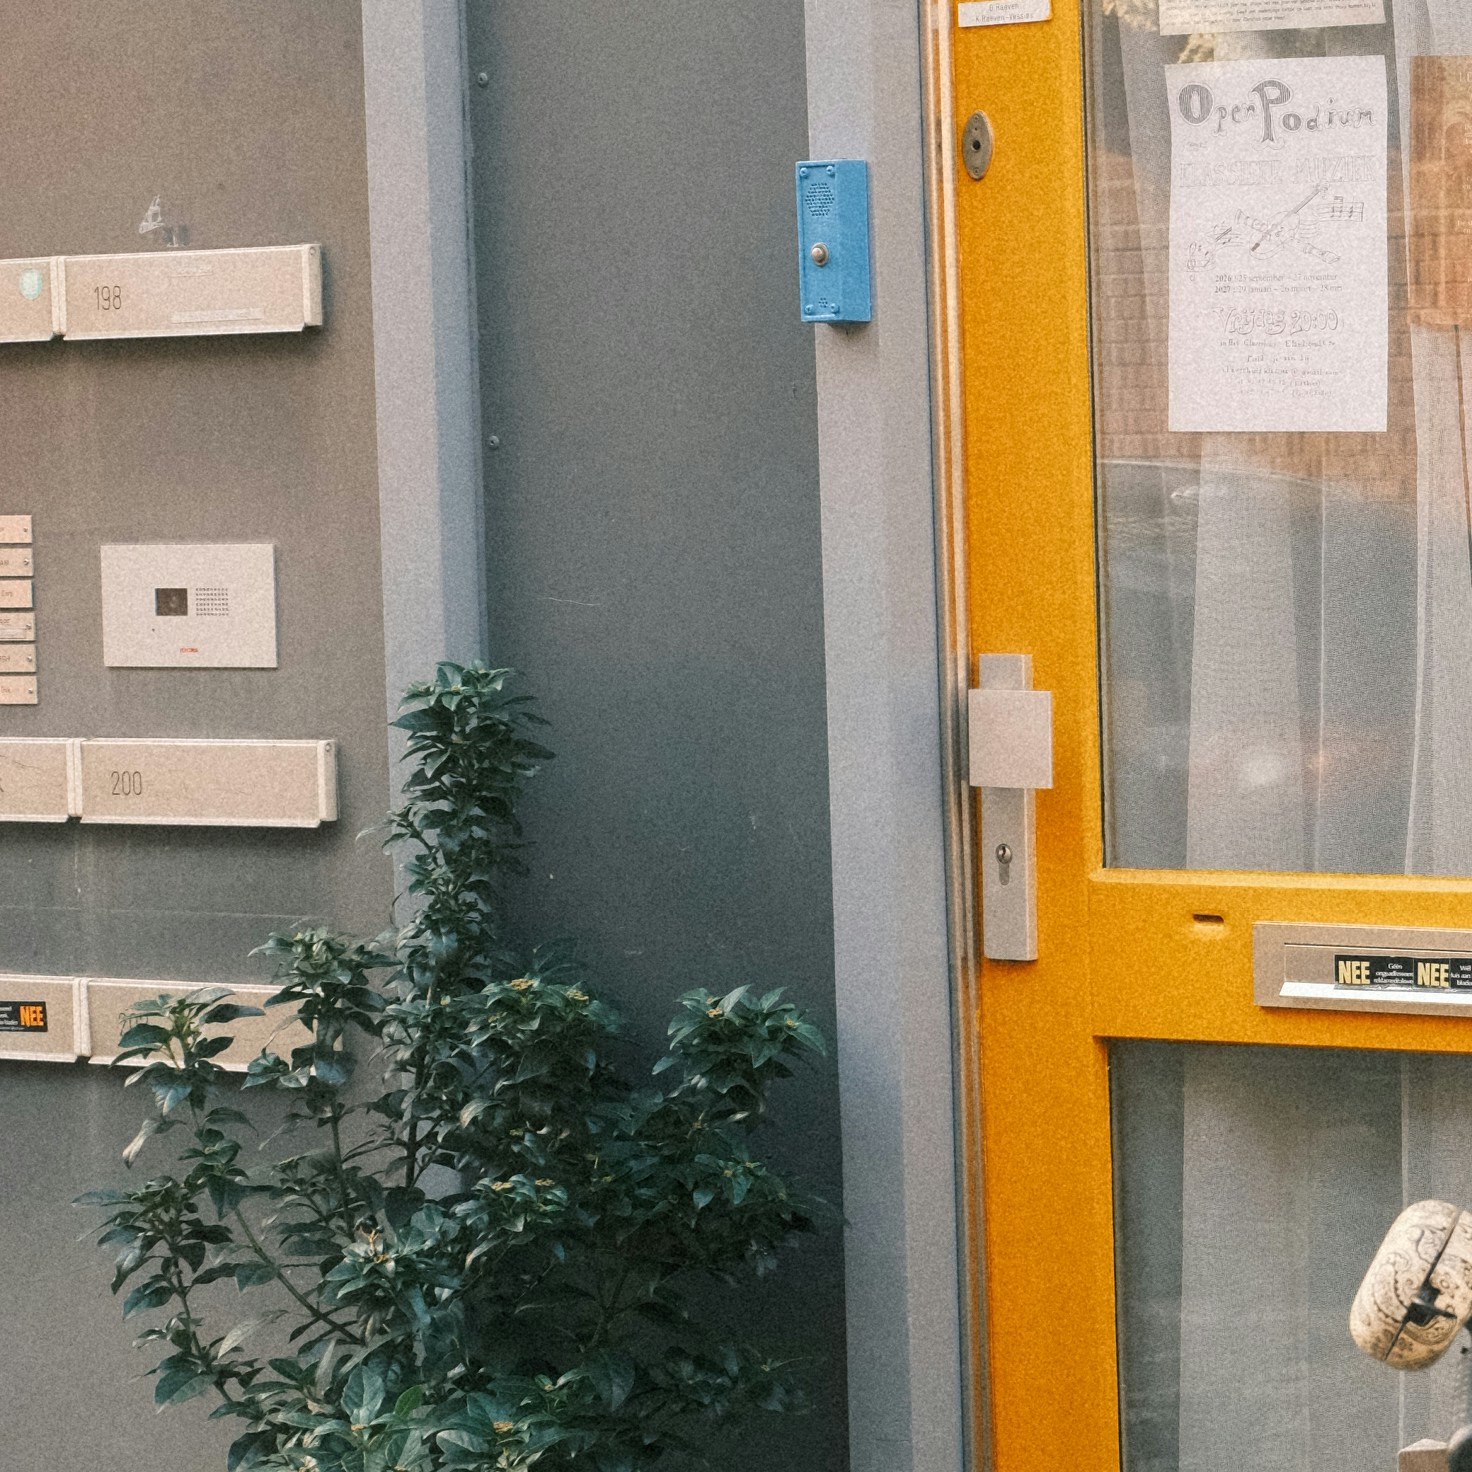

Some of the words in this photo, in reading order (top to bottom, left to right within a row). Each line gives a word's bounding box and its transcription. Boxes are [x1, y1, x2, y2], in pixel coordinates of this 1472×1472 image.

[1177, 81, 1257, 137] Open
[1250, 78, 1377, 151] Podium
[1214, 285, 1231, 293] 2027
[1215, 274, 1232, 282] 2026
[93, 285, 123, 311] 198
[1212, 306, 1287, 336] Vrijdag
[1289, 307, 1339, 336] 20:00
[111, 770, 143, 796] 200
[1338, 960, 1371, 985] NEE
[1417, 961, 1449, 987] NEE
[20, 1005, 44, 1026] NEE
